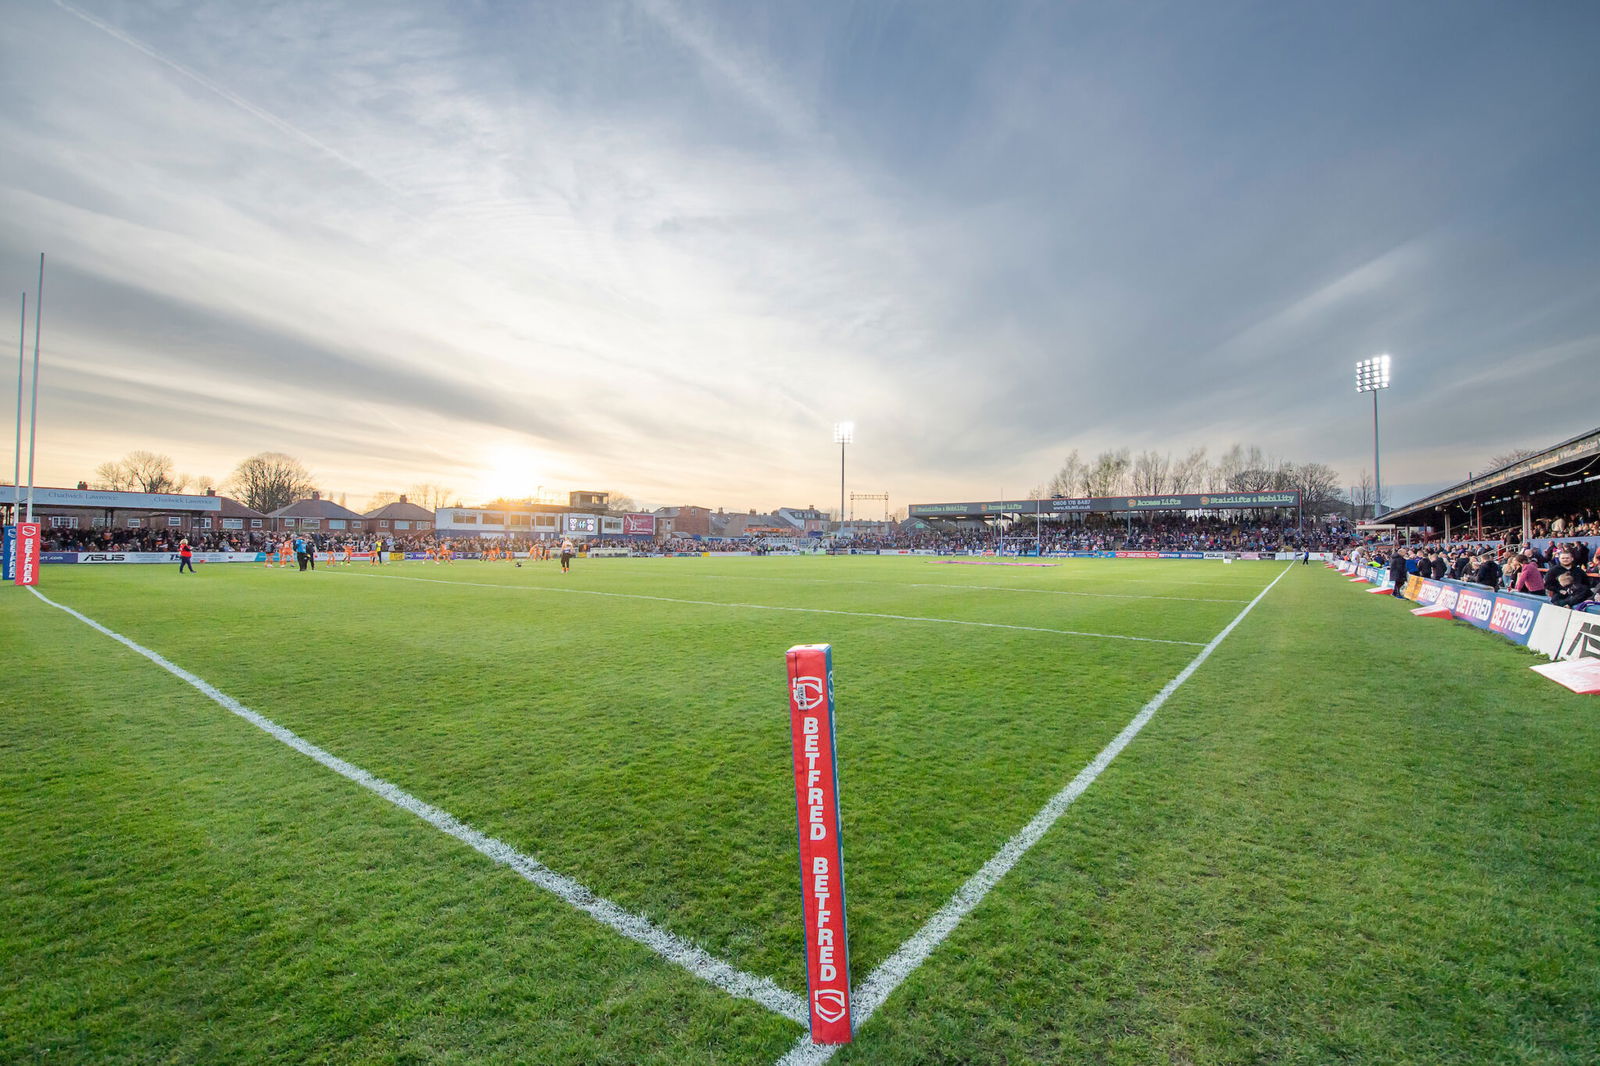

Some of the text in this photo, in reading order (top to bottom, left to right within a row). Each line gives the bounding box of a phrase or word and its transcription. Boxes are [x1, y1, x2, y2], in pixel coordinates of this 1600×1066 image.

[1258, 494, 1295, 503] Mobility
[23, 538, 34, 583] BETFRED
[1456, 593, 1492, 621] BETFRED
[1491, 602, 1534, 635] BETFRED
[803, 717, 827, 841] BETFRED
[812, 856, 837, 982] BETFRED
